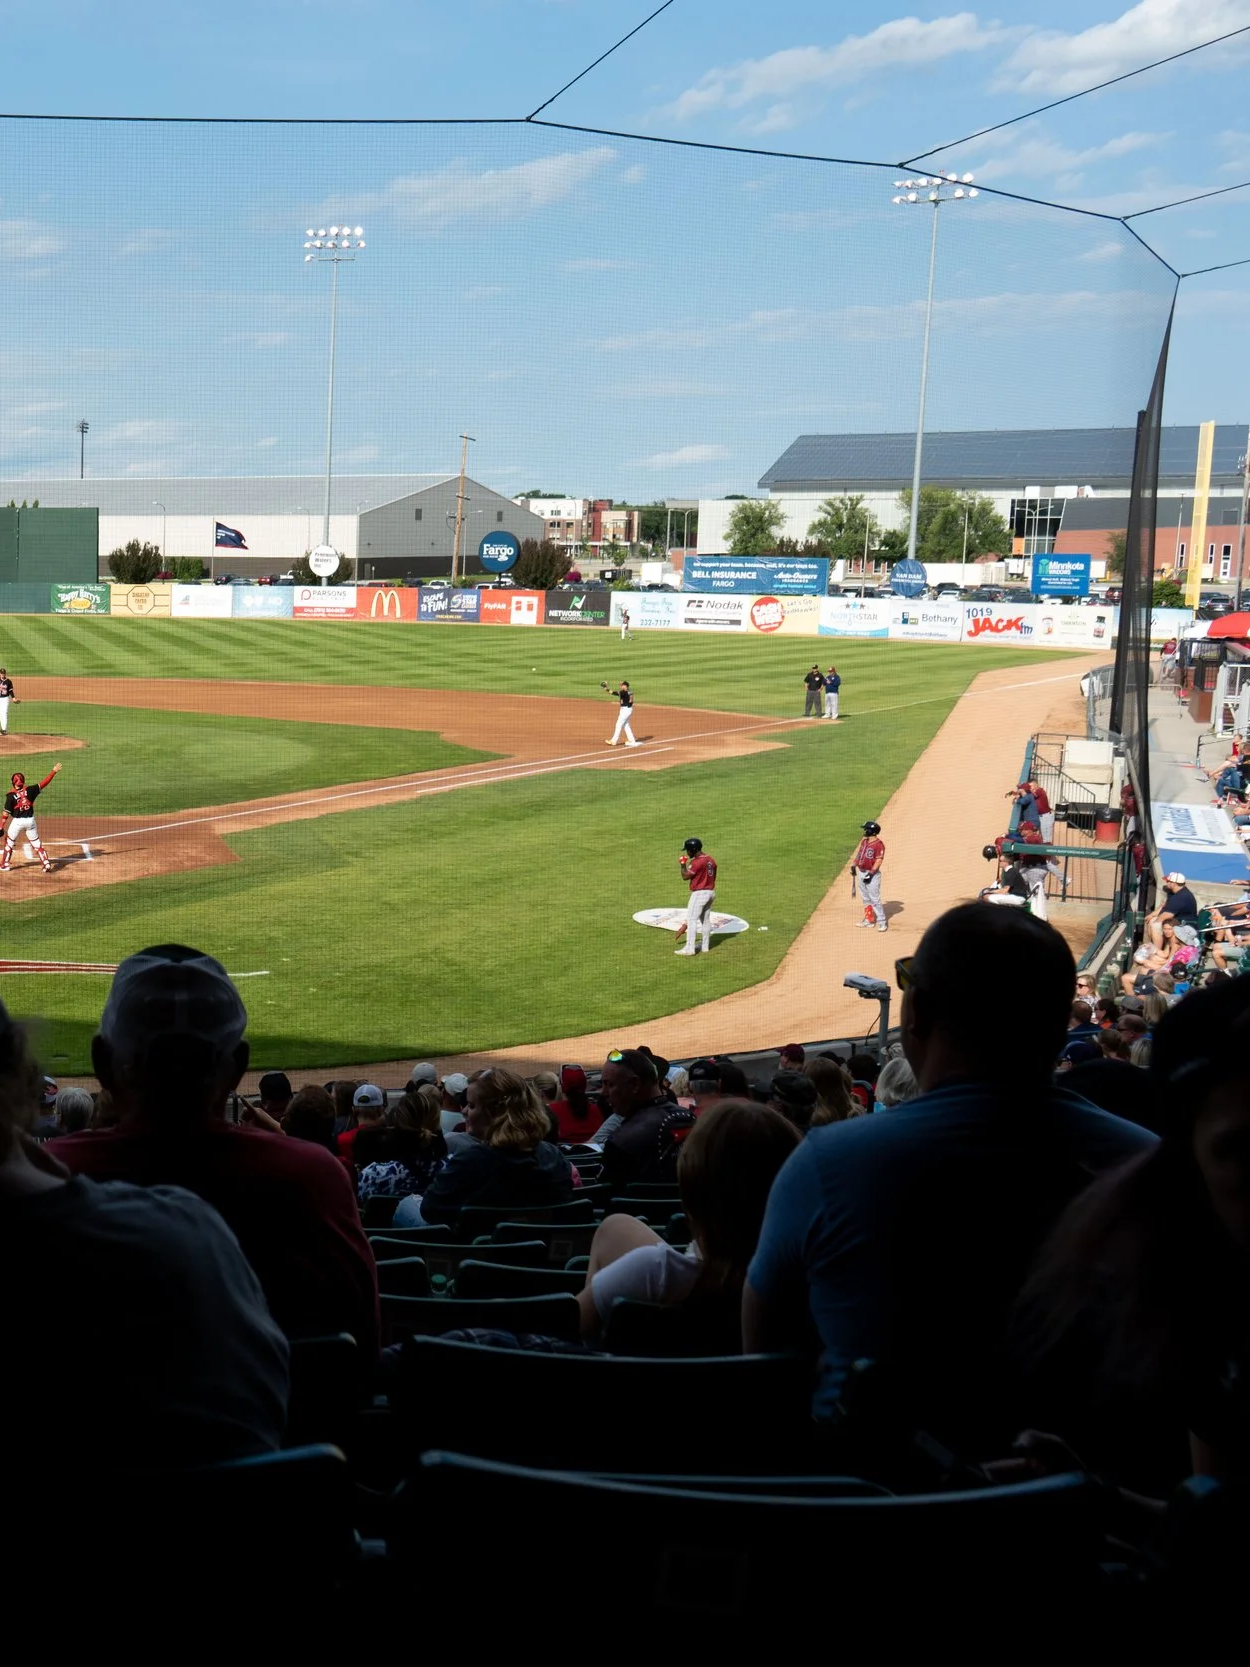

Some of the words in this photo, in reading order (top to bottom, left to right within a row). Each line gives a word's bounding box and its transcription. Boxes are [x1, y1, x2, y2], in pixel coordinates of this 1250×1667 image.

[483, 544, 514, 561] Fargo
[1049, 561, 1085, 571] Minnkota
[692, 570, 710, 578] BELL
[712, 571, 757, 579] INSURANCE
[428, 598, 448, 612] FUN!
[706, 600, 744, 610] Nodak
[922, 613, 958, 625] Bethany
[967, 616, 1025, 637] JACK
[1020, 622, 1033, 635] fm
